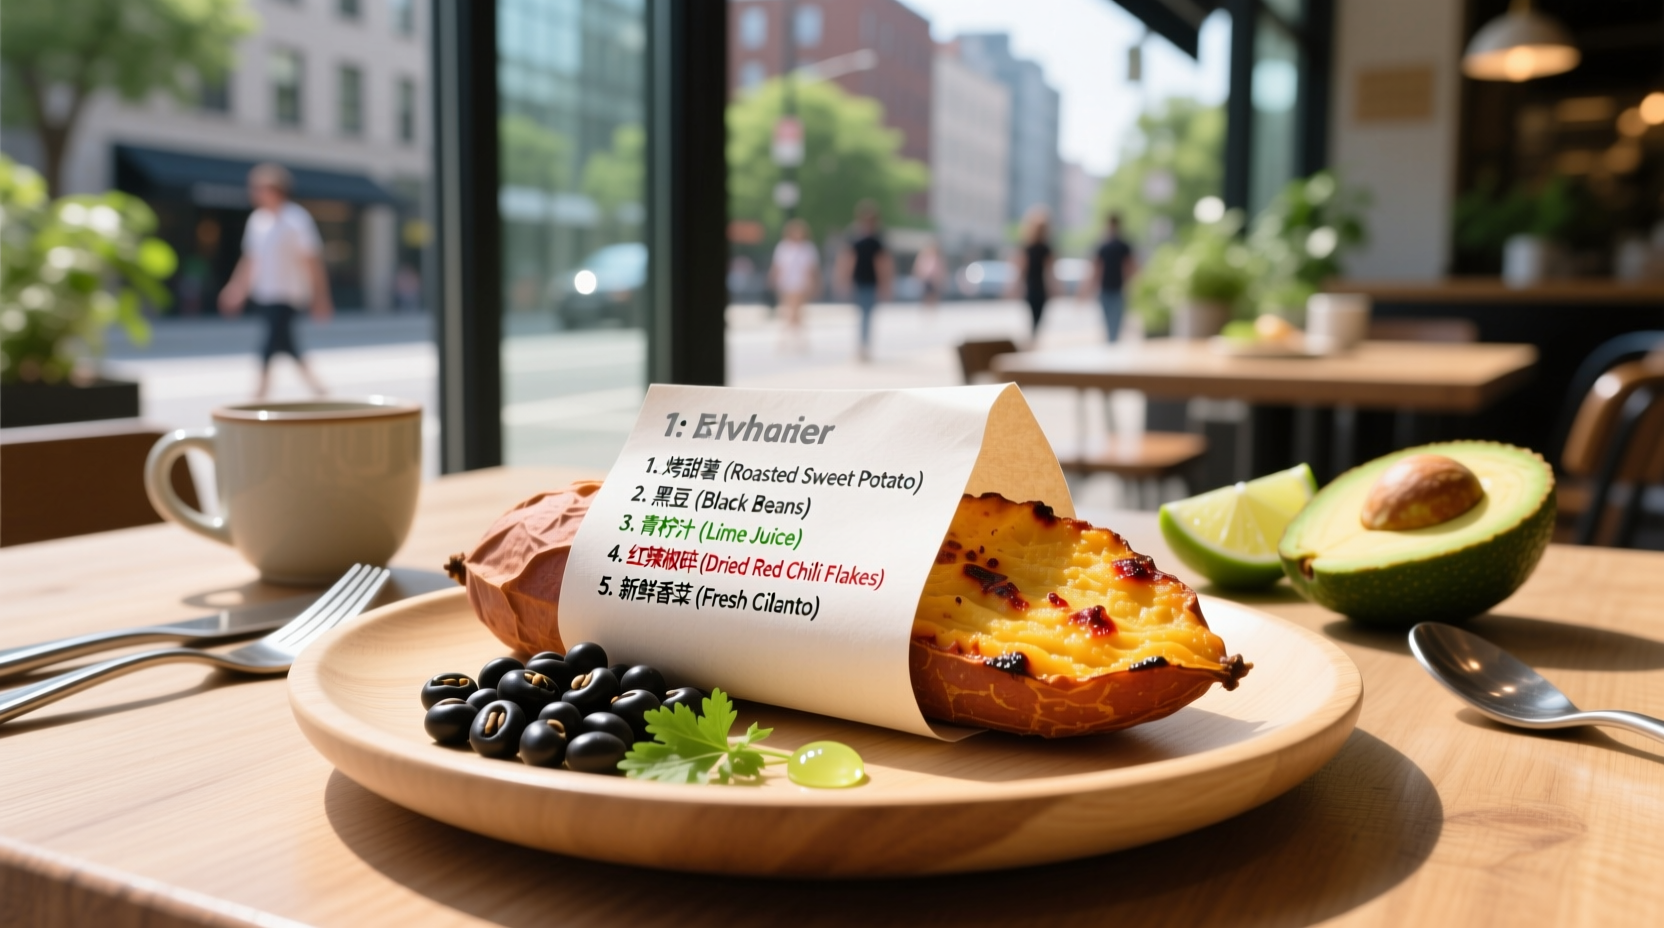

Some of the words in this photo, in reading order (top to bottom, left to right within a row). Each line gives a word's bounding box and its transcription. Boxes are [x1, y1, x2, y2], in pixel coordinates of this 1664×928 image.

[664, 412, 687, 438] 1:
[646, 457, 658, 474] 1.
[723, 461, 799, 483] (Roasted
[801, 467, 855, 487] Sweet
[857, 470, 924, 496] Potato)
[631, 485, 647, 503] 2.
[651, 485, 693, 509] 黑豆
[694, 490, 749, 512] (Black
[751, 494, 811, 521] Beans)
[619, 514, 635, 532] 3.
[698, 520, 748, 544] (Lime
[749, 526, 803, 551] Juice)
[607, 544, 623, 563] 4.
[700, 552, 751, 576] (Dried
[752, 558, 785, 579] Red
[786, 561, 824, 582] Chili
[824, 564, 885, 591] Flakes)
[597, 575, 613, 596] 5.
[695, 585, 748, 611] (Fresh
[752, 592, 820, 622] Cilanto)
